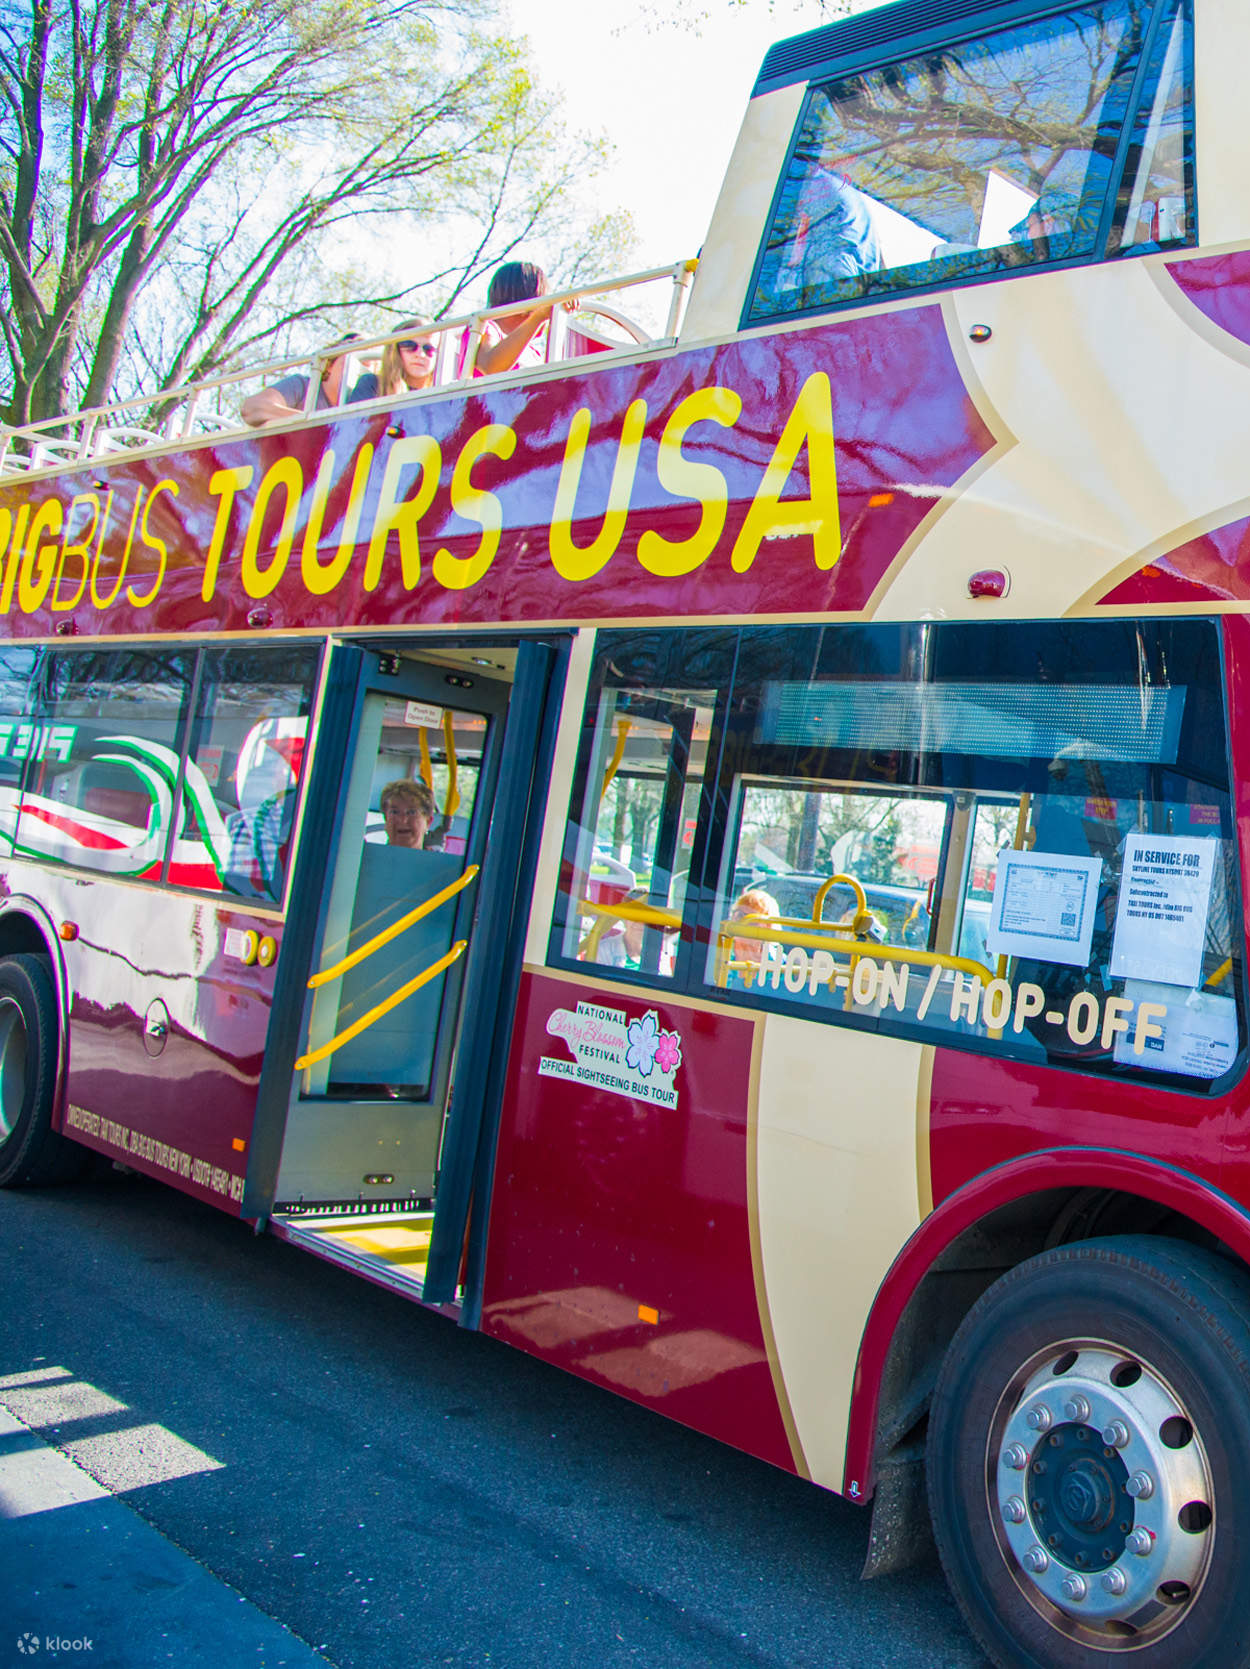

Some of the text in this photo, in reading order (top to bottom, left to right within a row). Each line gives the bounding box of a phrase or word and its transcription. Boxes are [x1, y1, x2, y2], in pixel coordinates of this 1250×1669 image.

[202, 423, 518, 604] TOURS
[548, 371, 843, 582] USA
[1133, 849, 1200, 867] IN SERVICE FOR
[757, 942, 910, 1012] HOP-ON
[950, 973, 1168, 1055] HOP-OFF
[577, 1005, 624, 1024] NATIONAL
[579, 1045, 621, 1064] FESTIVAL
[541, 1059, 675, 1103] OFFICIAL SIGHTSEEING BUS TOUR
